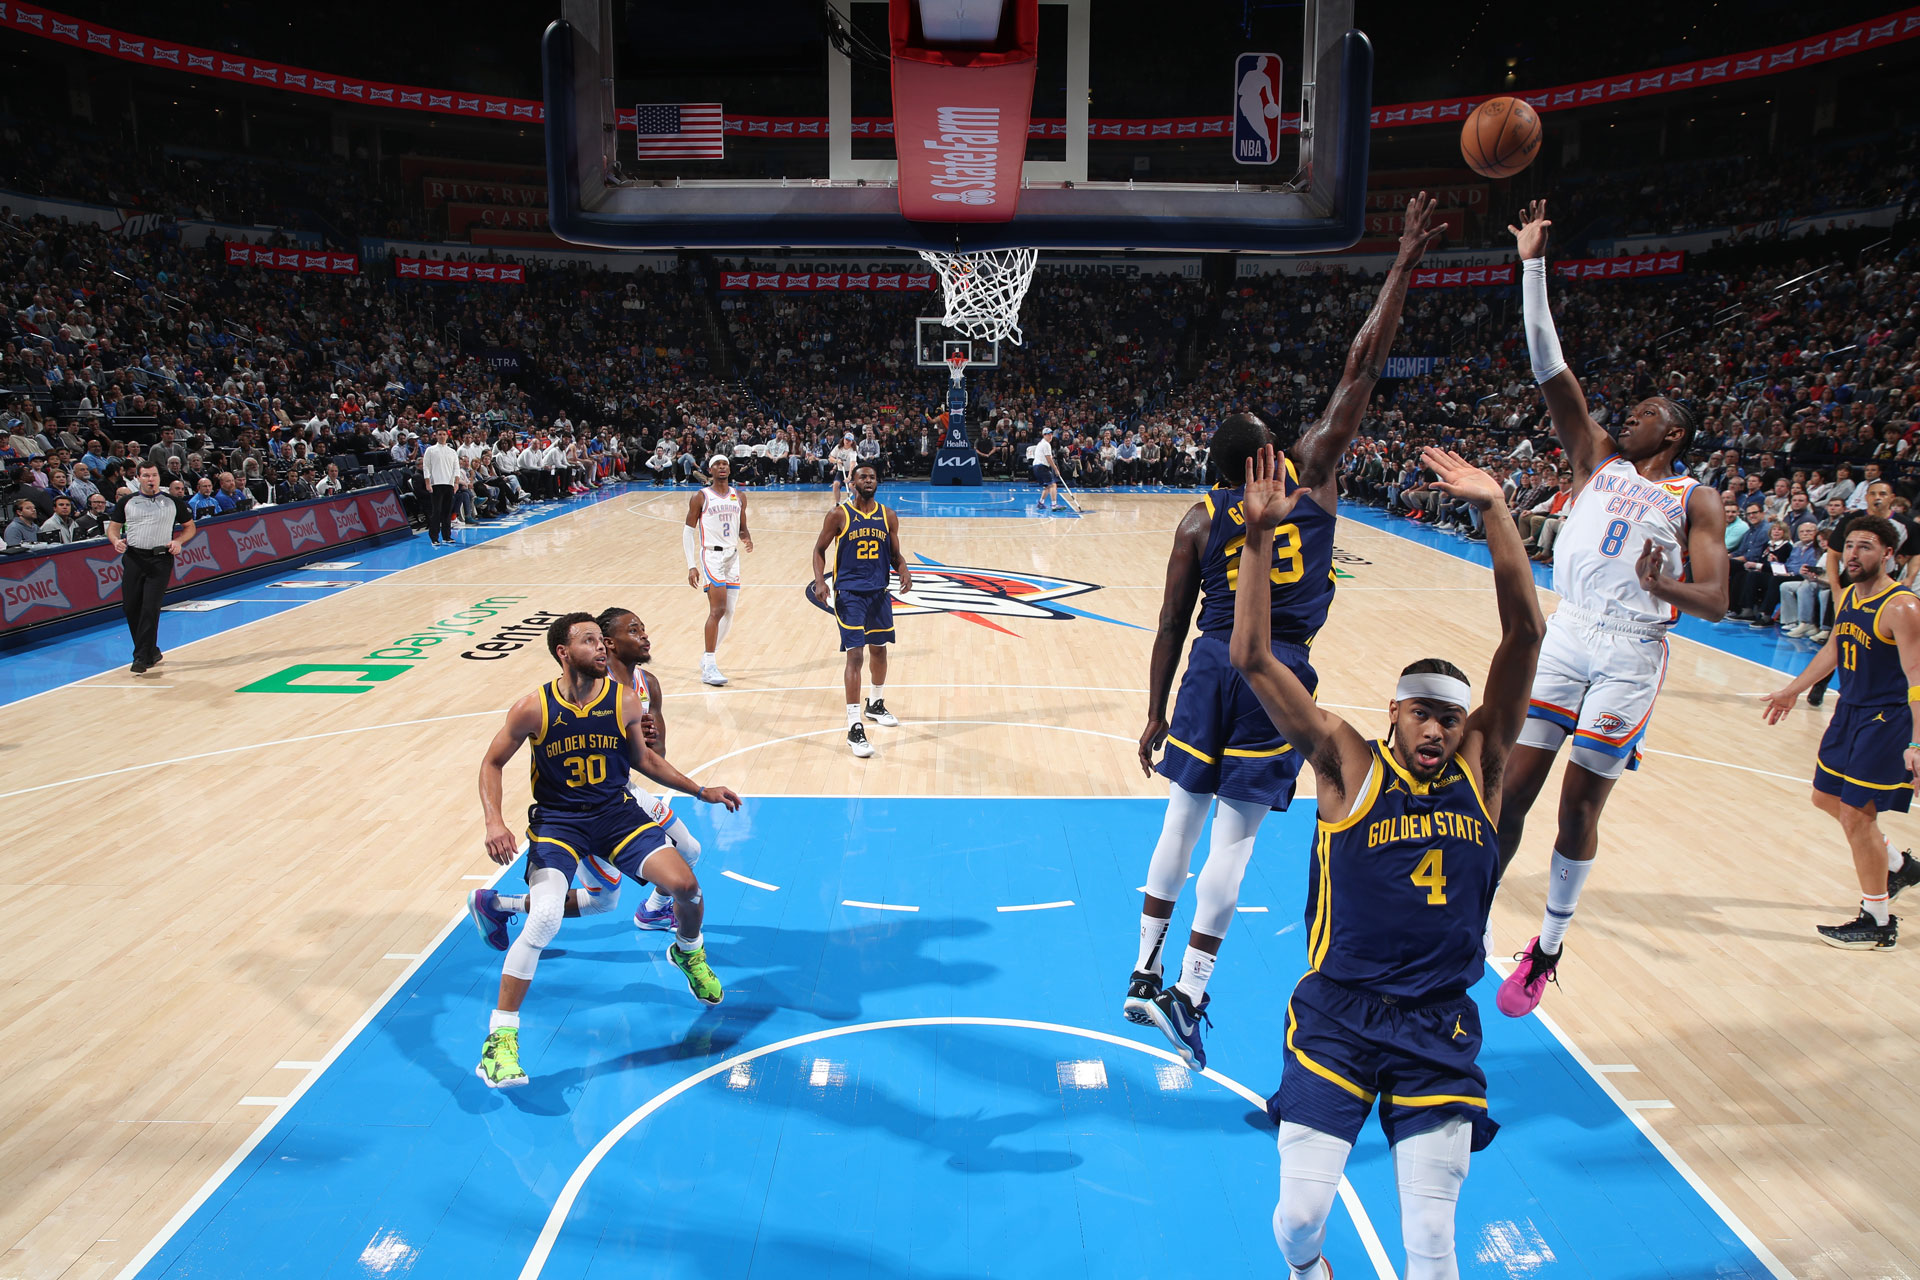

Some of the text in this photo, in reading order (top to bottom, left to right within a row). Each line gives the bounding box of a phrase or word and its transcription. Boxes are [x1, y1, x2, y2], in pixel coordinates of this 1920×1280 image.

[1240, 140, 1262, 157] NBA
[708, 504, 740, 516] OKLAHOMA
[1593, 473, 1686, 521] OKLAHOMA
[1606, 496, 1652, 522] CITY
[718, 513, 732, 522] CITY
[723, 523, 730, 537] 2
[848, 528, 887, 542] GOLDEN STATE
[1599, 518, 1631, 558] 8
[5, 578, 58, 606] SONIC
[174, 546, 211, 567] SONIC
[237, 533, 268, 552] SONIC
[290, 521, 316, 539] SONIC
[336, 512, 360, 528] SONIC
[377, 504, 398, 519] SONIC
[856, 540, 879, 559] 22
[362, 596, 528, 660] paycom
[460, 610, 563, 660] center
[1842, 641, 1856, 671] 11
[546, 734, 619, 758] GOLDEN STATE
[564, 754, 606, 788] 30
[1432, 773, 1465, 789] Rakuten
[1368, 812, 1484, 848] GOLDEN STATE
[1410, 849, 1447, 905] 4
